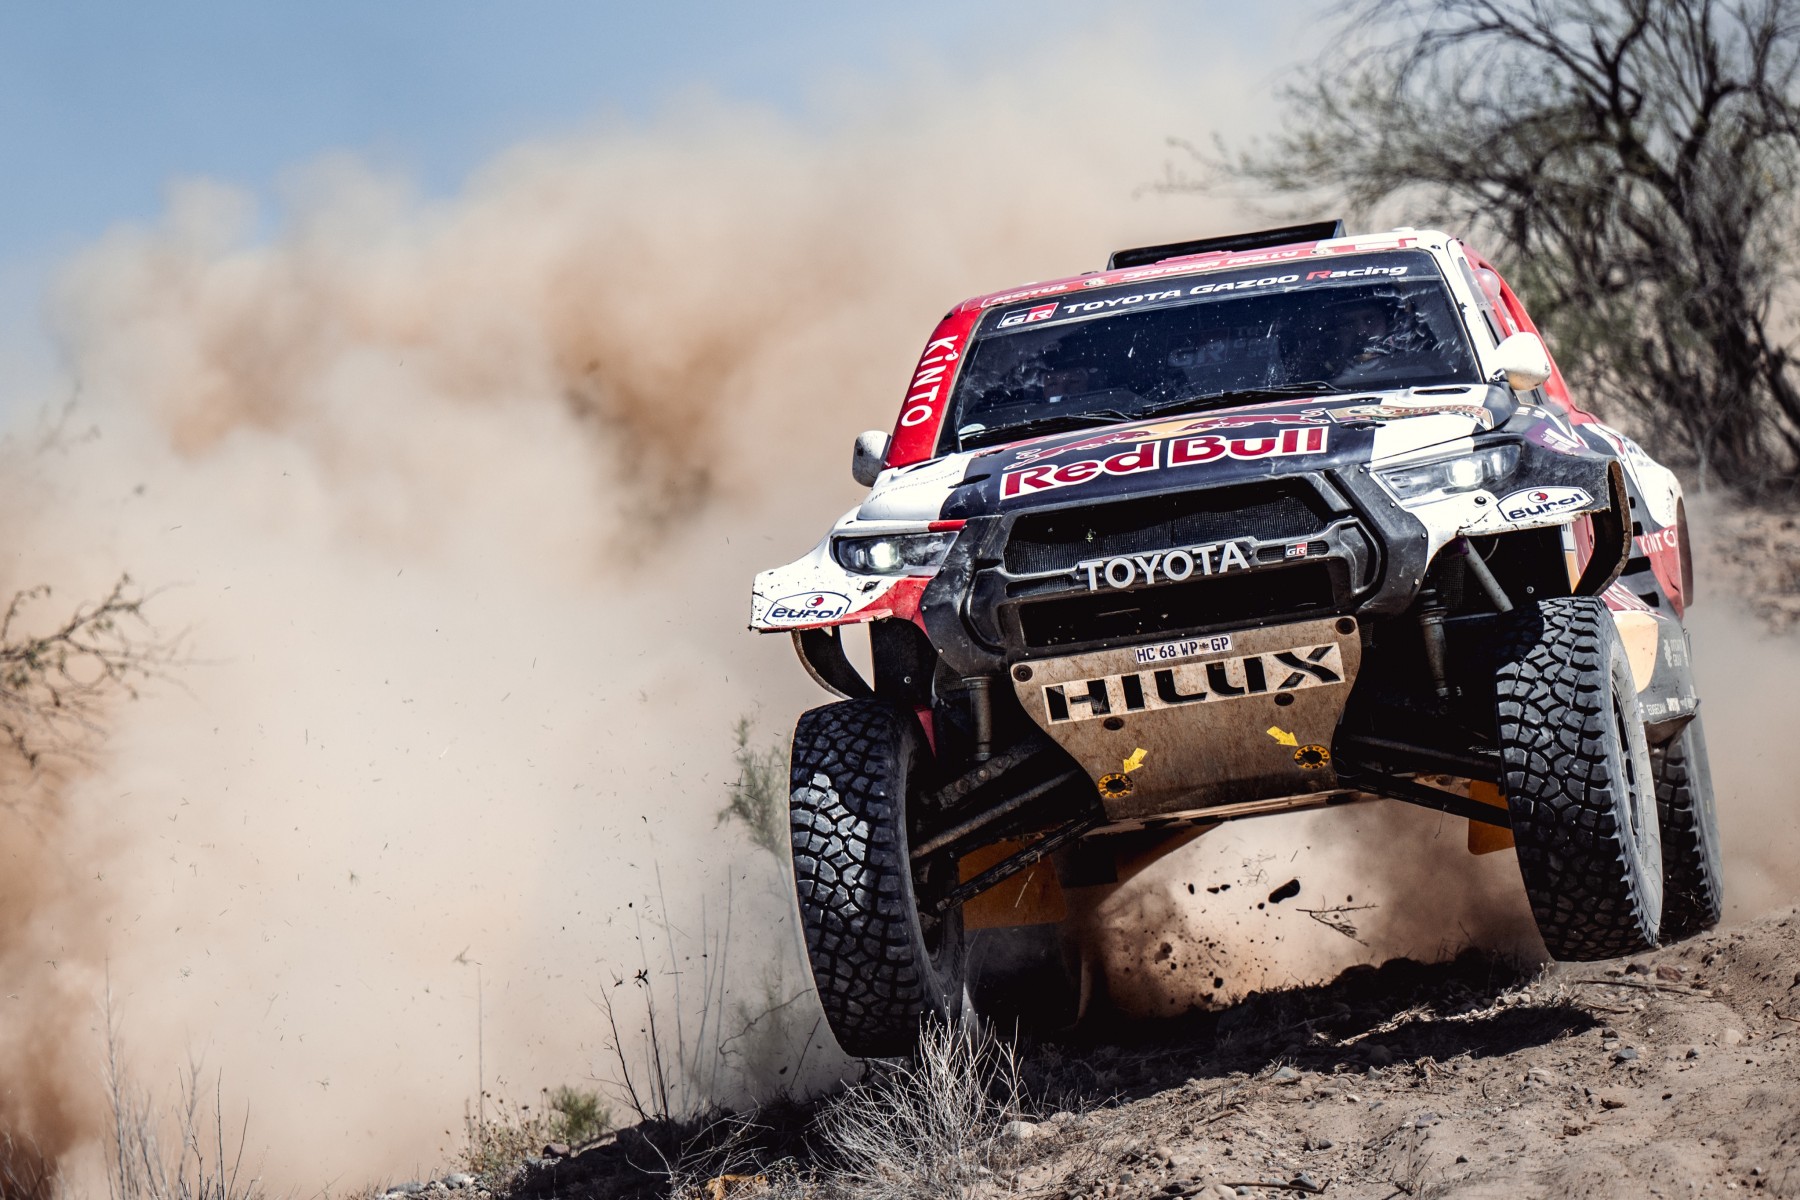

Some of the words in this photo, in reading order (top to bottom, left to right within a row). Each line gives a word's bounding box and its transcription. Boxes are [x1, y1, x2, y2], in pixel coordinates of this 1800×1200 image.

[993, 284, 1068, 301] MOTUL
[1063, 289, 1181, 314] TOYOTA
[1190, 273, 1299, 295] GAZOO
[1306, 266, 1408, 282] Racing
[999, 306, 1055, 328] GR
[1001, 441, 1160, 498] Red
[1168, 427, 1328, 467] Bull
[1508, 493, 1585, 519] eurol
[1285, 545, 1307, 557] GR
[1079, 541, 1250, 591] TOYOTA
[771, 606, 843, 618] eurol
[1136, 648, 1155, 662] HC
[1159, 645, 1176, 659] 68
[1180, 641, 1198, 655] WP
[1210, 636, 1229, 651] GP
[1045, 645, 1341, 721] HILUX
